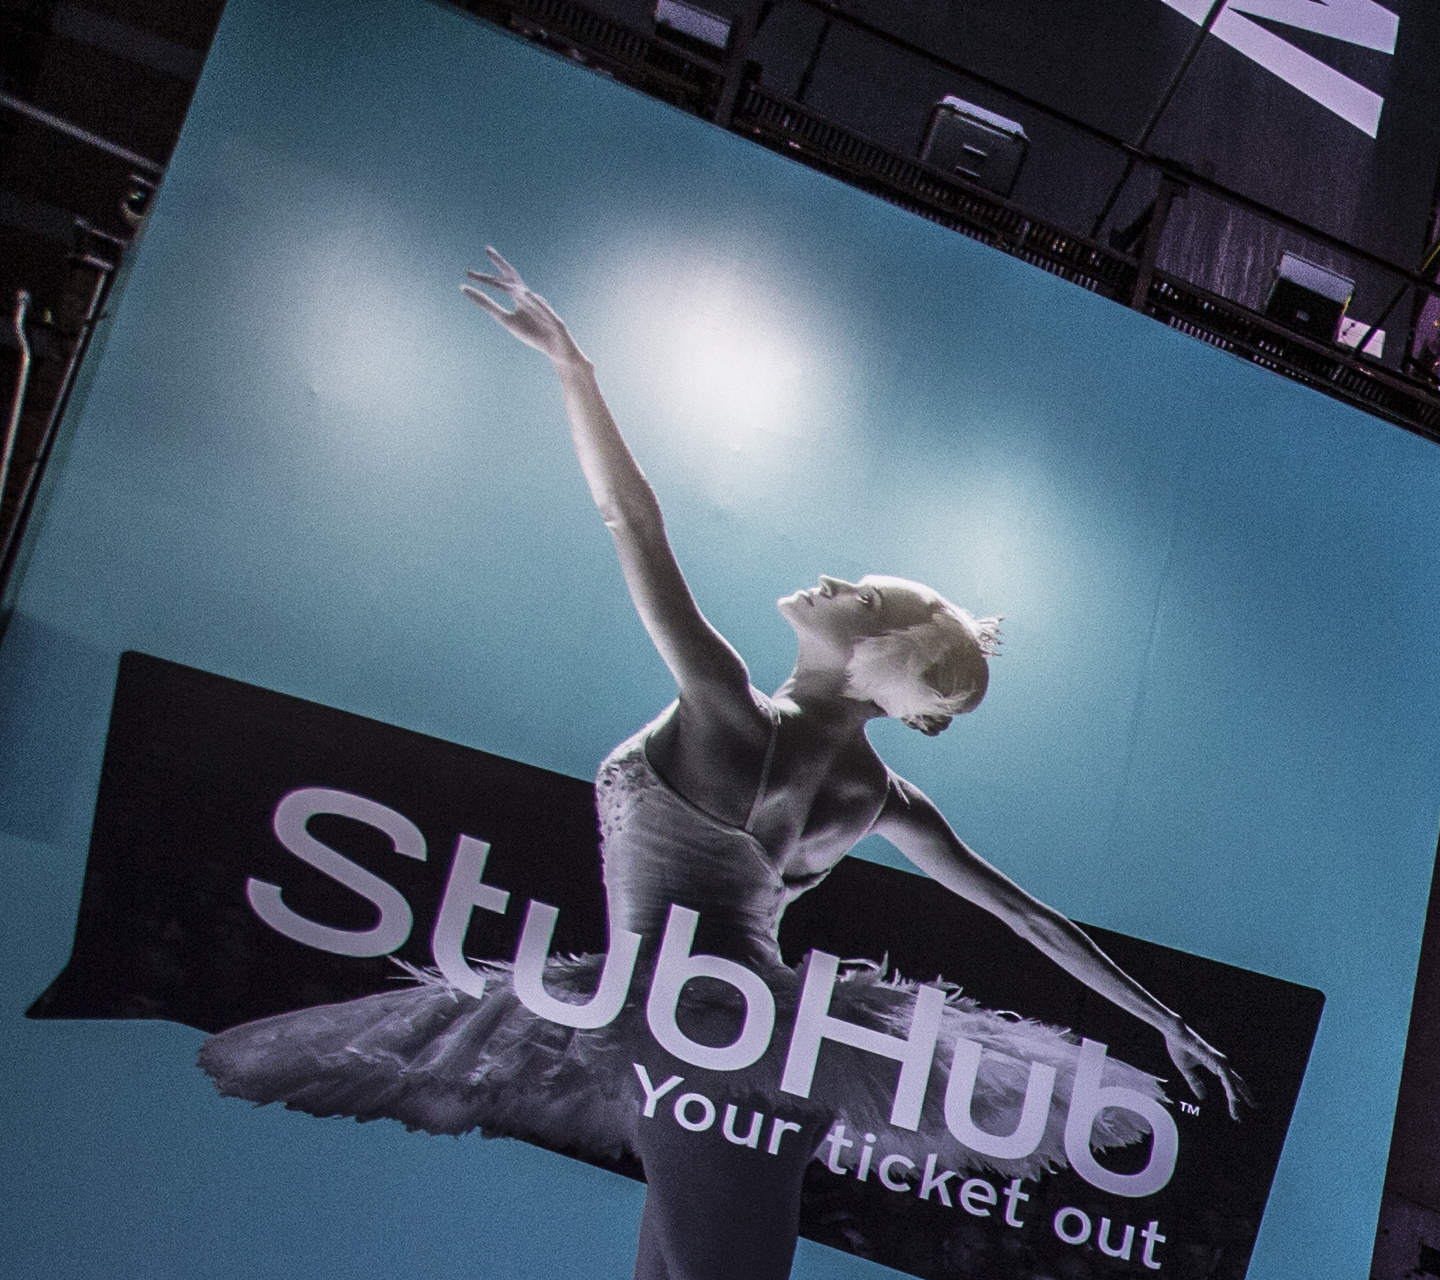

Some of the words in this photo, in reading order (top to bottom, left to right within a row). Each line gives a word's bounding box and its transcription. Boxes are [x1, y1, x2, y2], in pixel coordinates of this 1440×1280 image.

[246, 786, 1180, 1199] StubHub
[633, 1063, 801, 1158] Your
[825, 1126, 1031, 1228] ticket
[1054, 1206, 1167, 1271] out
